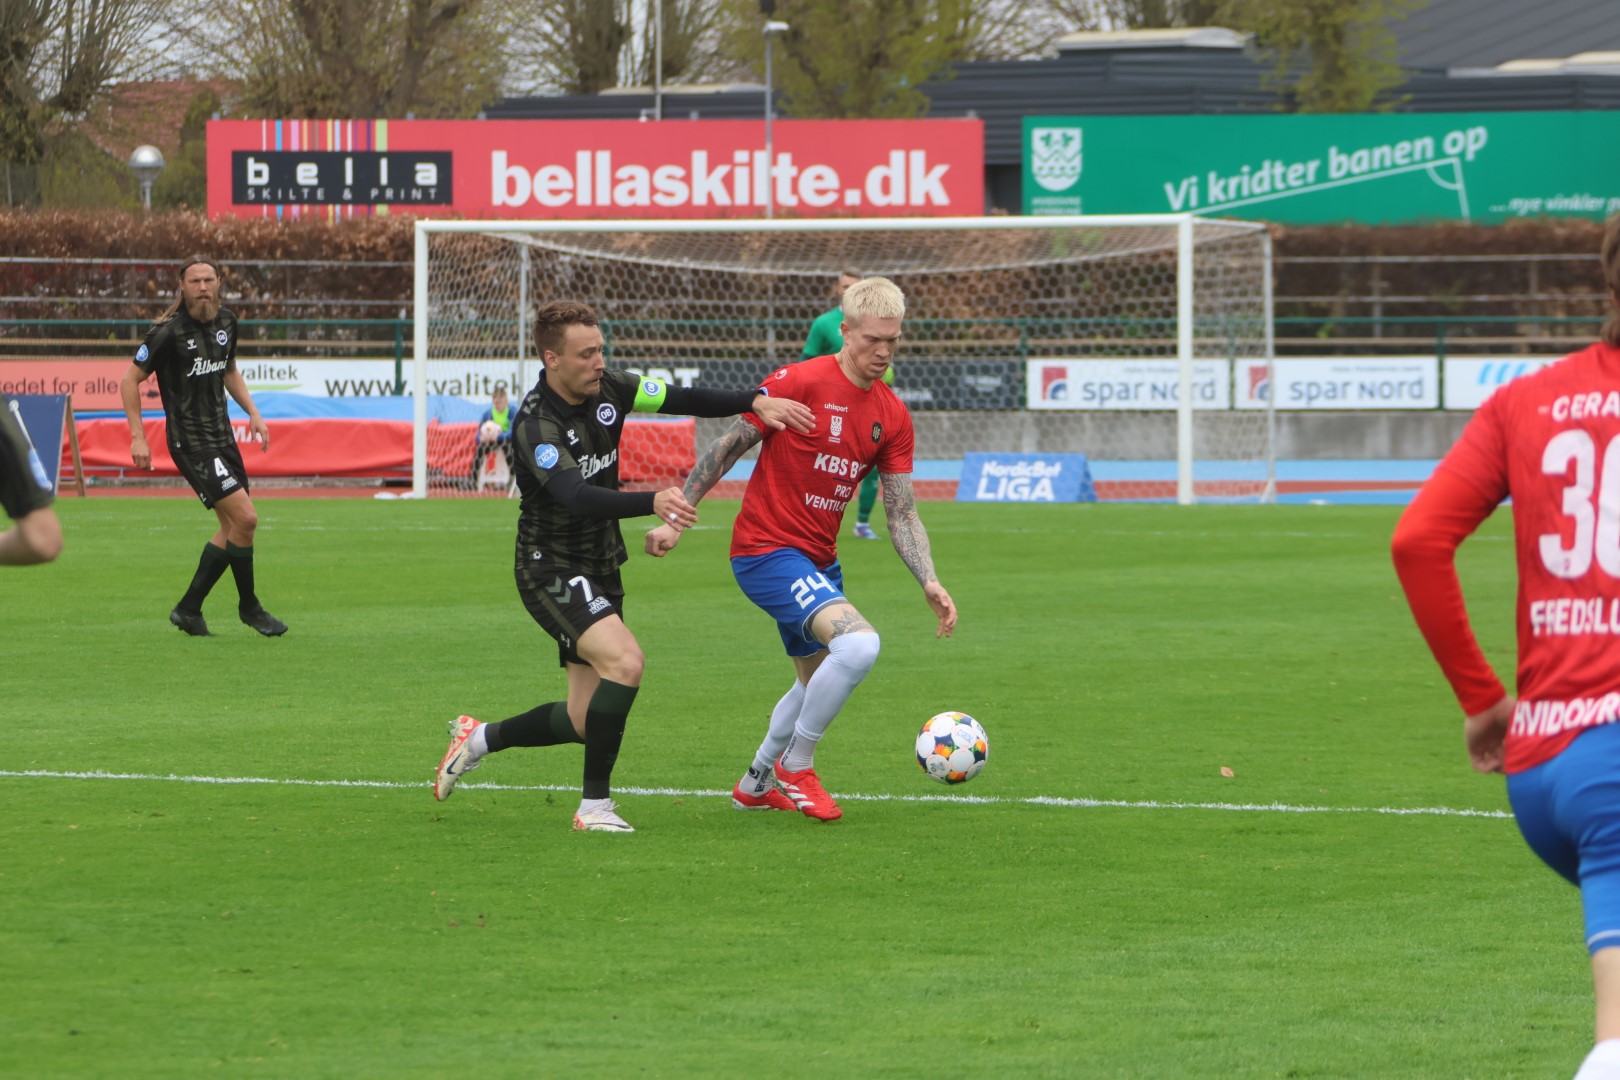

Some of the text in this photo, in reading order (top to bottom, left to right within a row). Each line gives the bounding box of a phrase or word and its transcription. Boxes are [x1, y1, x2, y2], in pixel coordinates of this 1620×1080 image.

[247, 156, 438, 186] bella
[491, 150, 950, 207] bellaskilte.dk
[1164, 125, 1488, 212] Vi kridter banen op
[247, 188, 438, 200] SKILTE & PRINT
[0, 377, 119, 395] edet for alle
[1082, 381, 1143, 407] spar
[1289, 377, 1424, 408] spar Nord
[824, 402, 849, 413] uhlsport
[213, 457, 229, 477] 4
[814, 452, 849, 476] KBS
[976, 477, 1055, 501] LIGA
[568, 575, 594, 603] 7
[790, 571, 836, 610] 24
[1510, 691, 1620, 737] HVIDOVR
